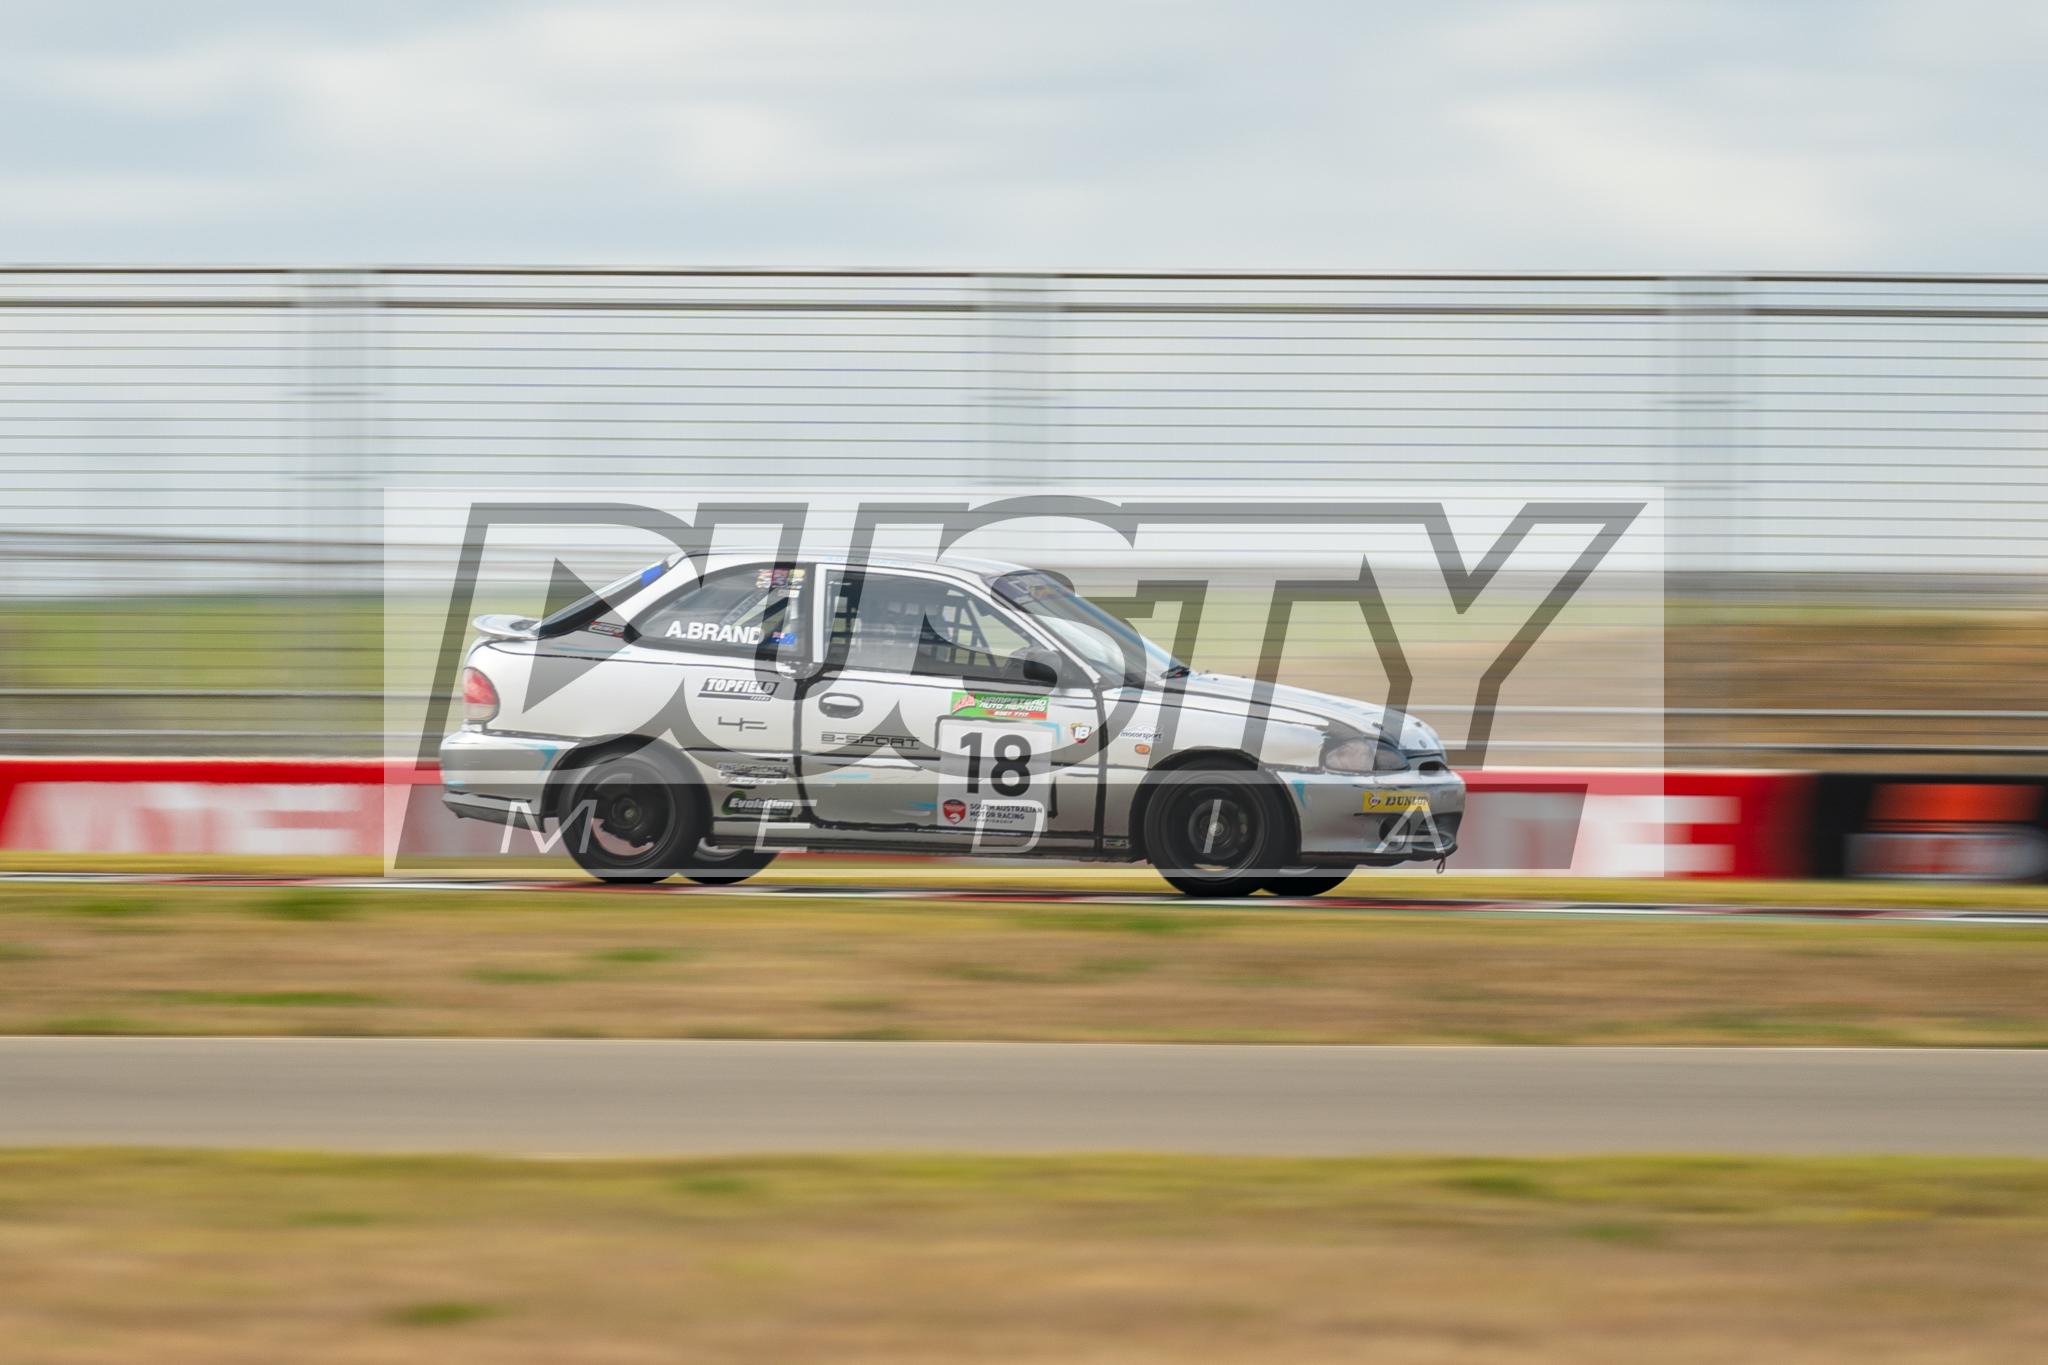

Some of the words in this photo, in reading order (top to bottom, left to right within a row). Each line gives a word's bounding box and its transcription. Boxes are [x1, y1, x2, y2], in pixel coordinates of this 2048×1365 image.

[665, 620, 765, 645] A.BRAND
[707, 679, 777, 694] TOPFIELD
[979, 702, 1003, 710] AUTO
[1074, 726, 1091, 739] 18
[821, 733, 919, 747] B-SPORT
[960, 731, 1032, 797] 18
[729, 797, 794, 809] Evolution
